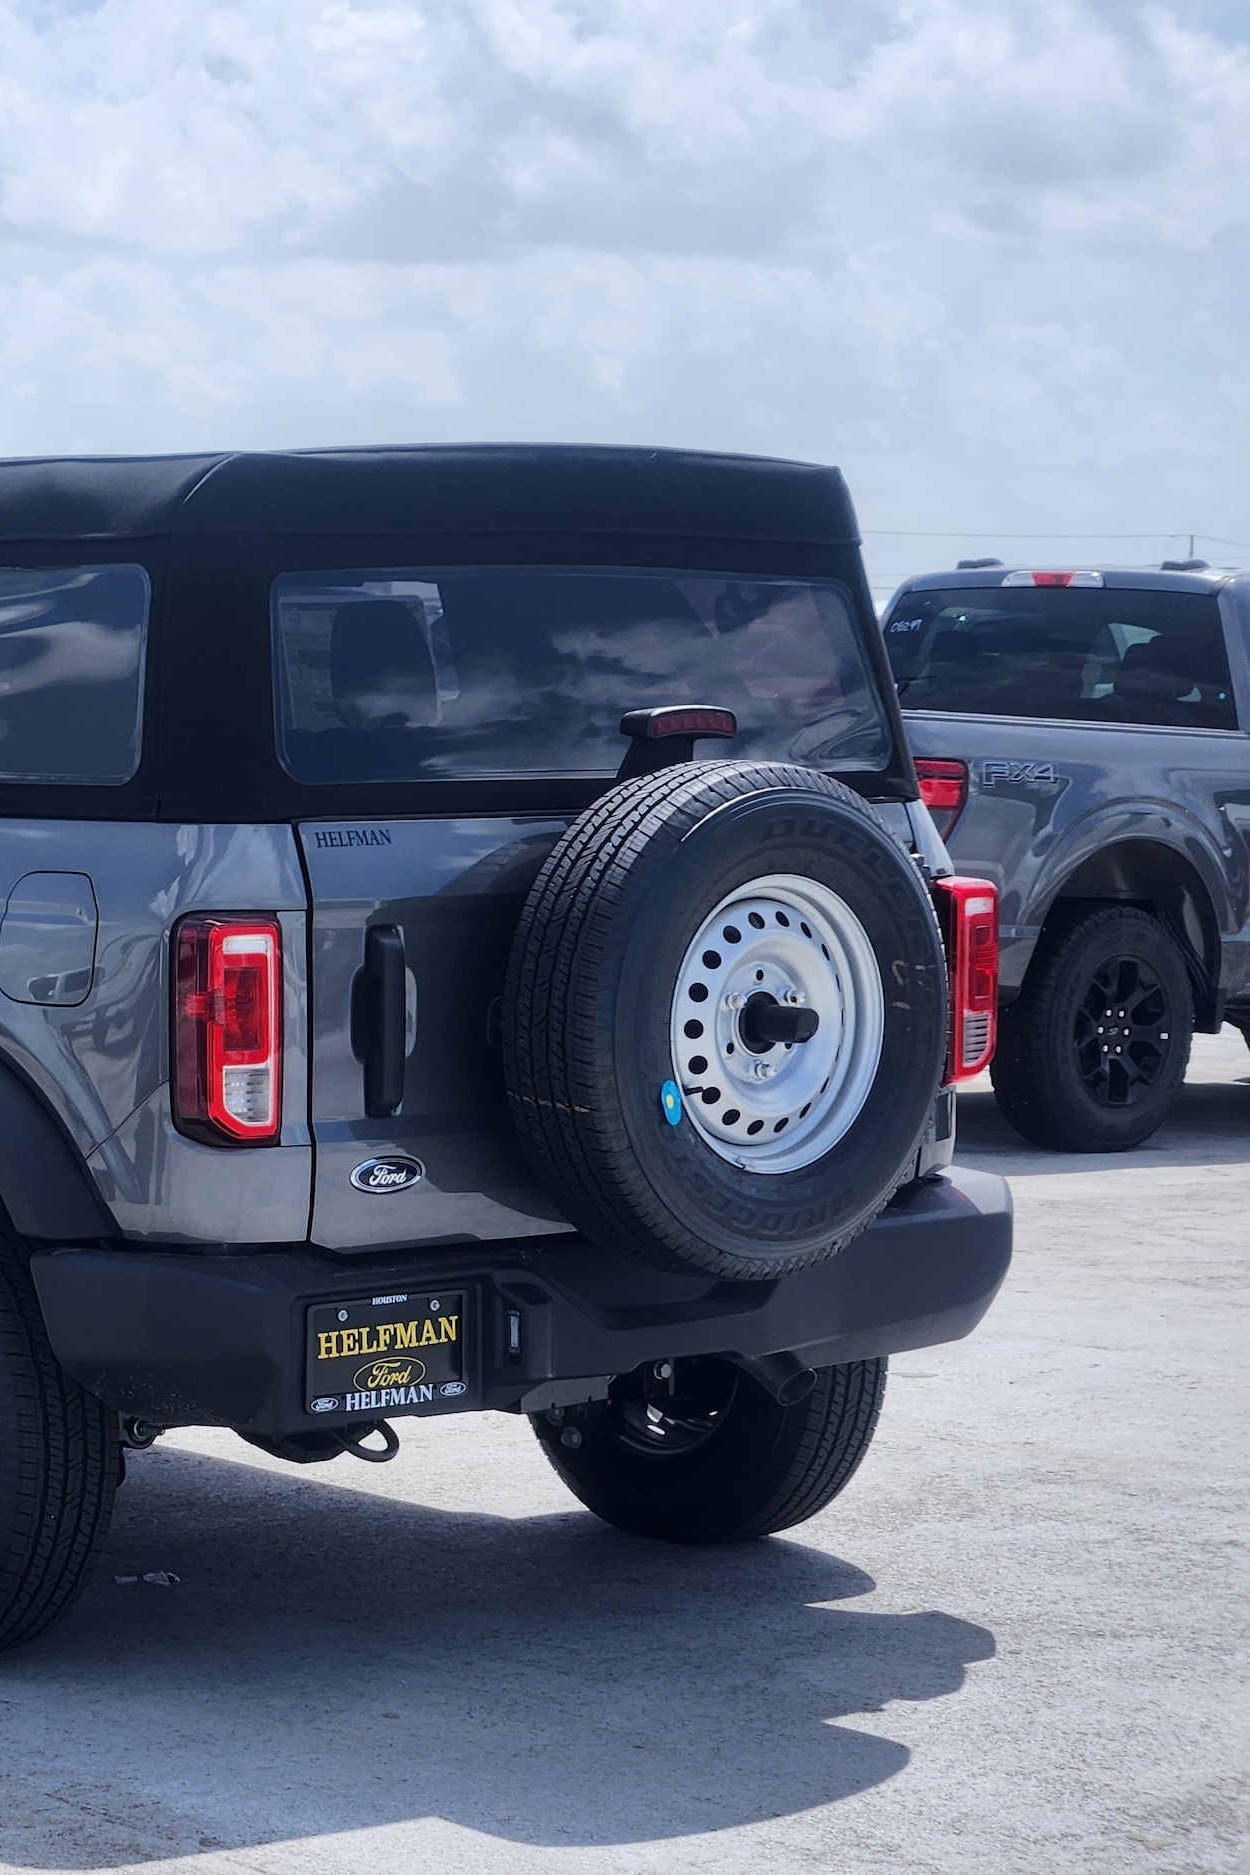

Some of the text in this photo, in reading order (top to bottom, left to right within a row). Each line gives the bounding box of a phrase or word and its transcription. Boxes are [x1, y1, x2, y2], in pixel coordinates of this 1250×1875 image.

[982, 761, 1059, 787] FX4
[314, 829, 392, 848] HELFMAN
[368, 1164, 408, 1186] Ford
[372, 1294, 408, 1306] HOUSTON
[317, 1315, 459, 1360] HELFMAN
[367, 1361, 412, 1388] Ford
[344, 1384, 434, 1412] HELFMAN
